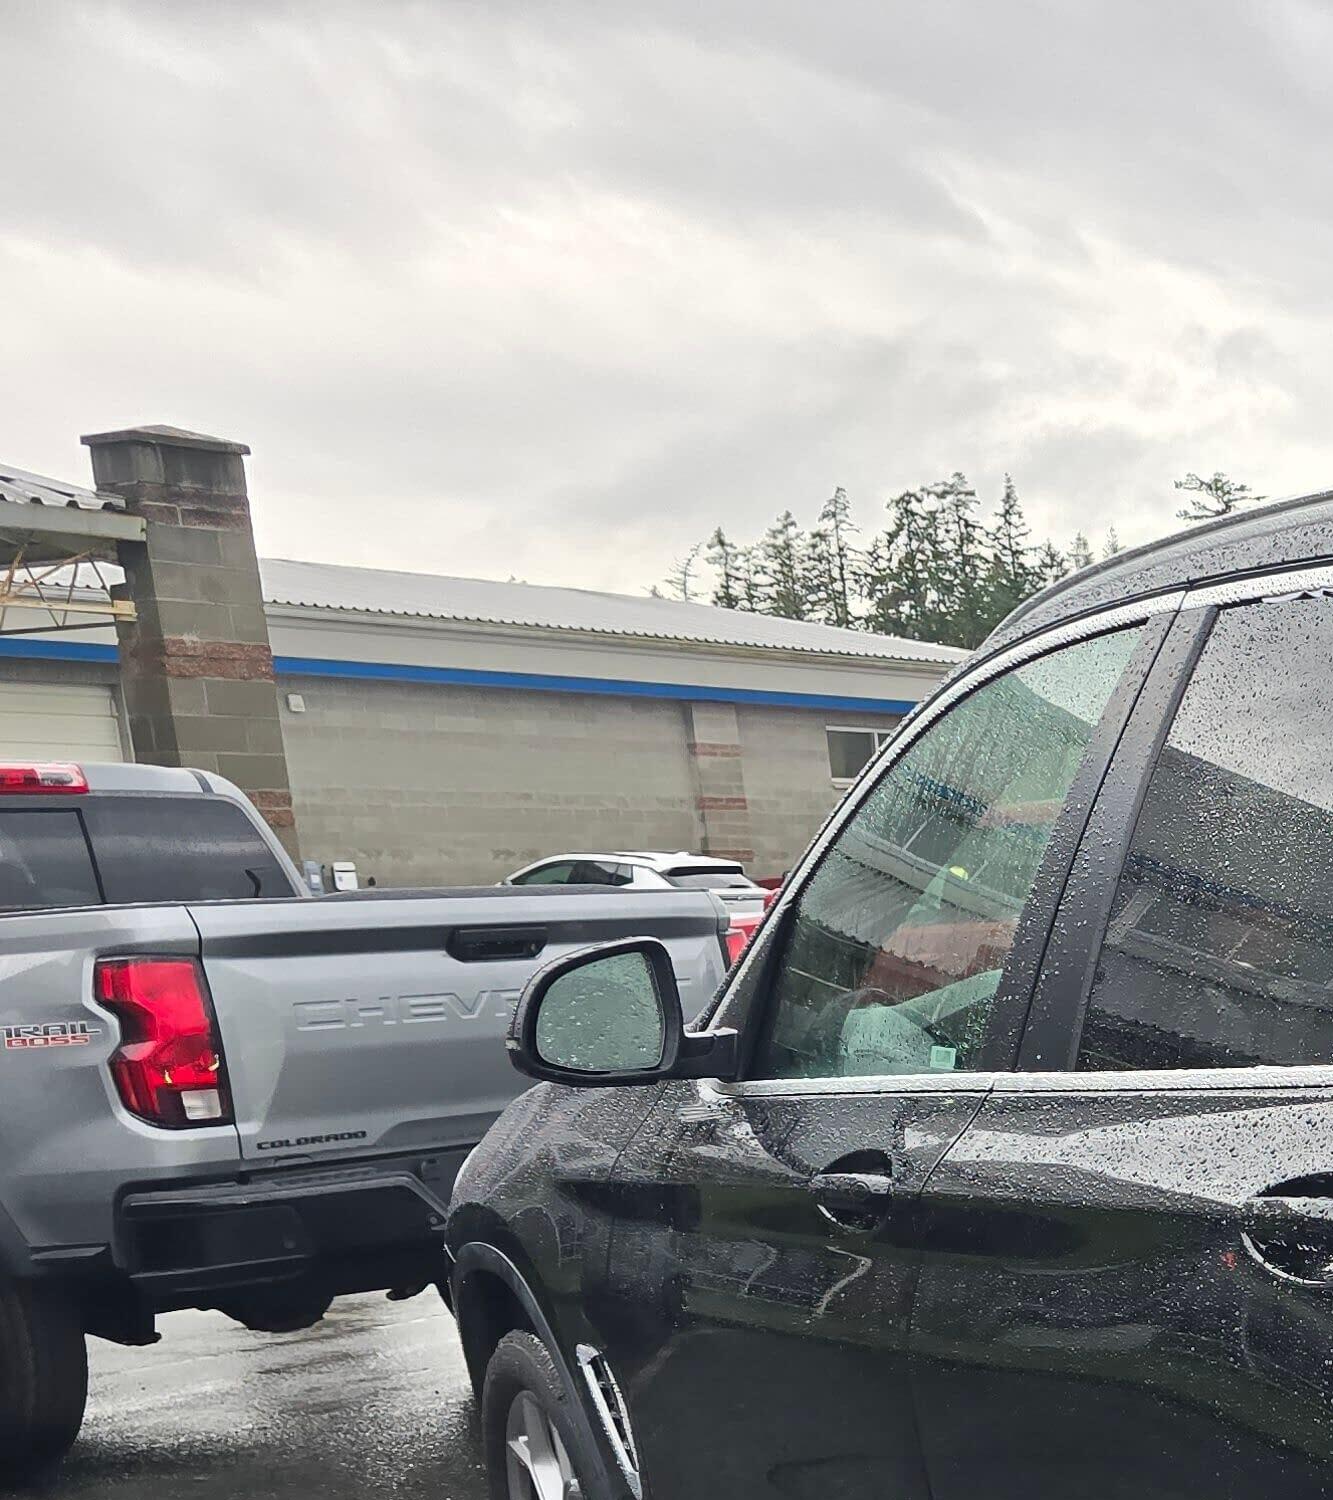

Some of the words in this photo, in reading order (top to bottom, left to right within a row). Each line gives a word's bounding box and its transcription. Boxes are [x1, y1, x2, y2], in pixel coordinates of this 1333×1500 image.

[0, 1020, 102, 1039] TRAIL
[5, 1035, 90, 1049] BOSS
[257, 1130, 367, 1150] COLORADO
